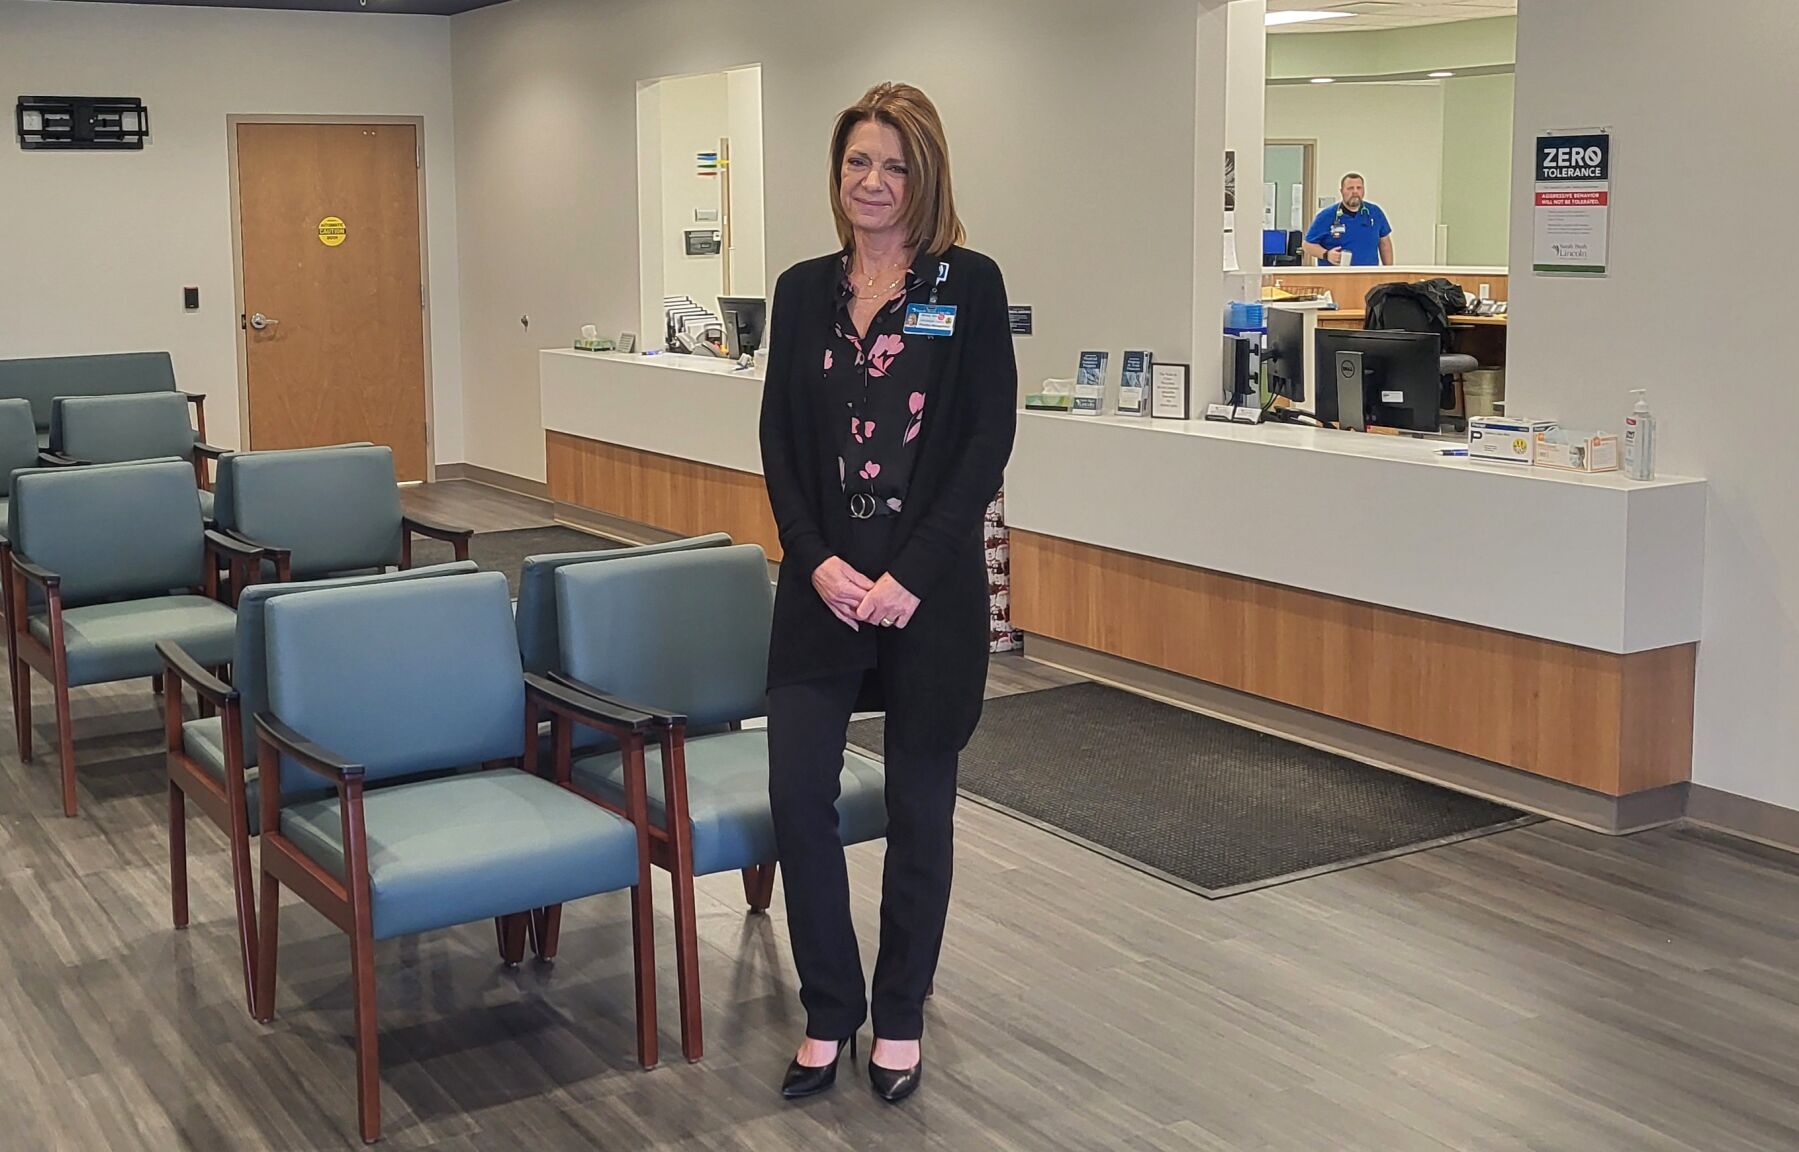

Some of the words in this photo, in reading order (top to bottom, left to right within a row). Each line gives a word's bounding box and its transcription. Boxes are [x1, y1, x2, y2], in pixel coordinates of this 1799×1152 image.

[1543, 147, 1602, 167] ZERO
[1543, 167, 1601, 178] TOLERANCE
[1559, 249, 1587, 257] Lincoln
